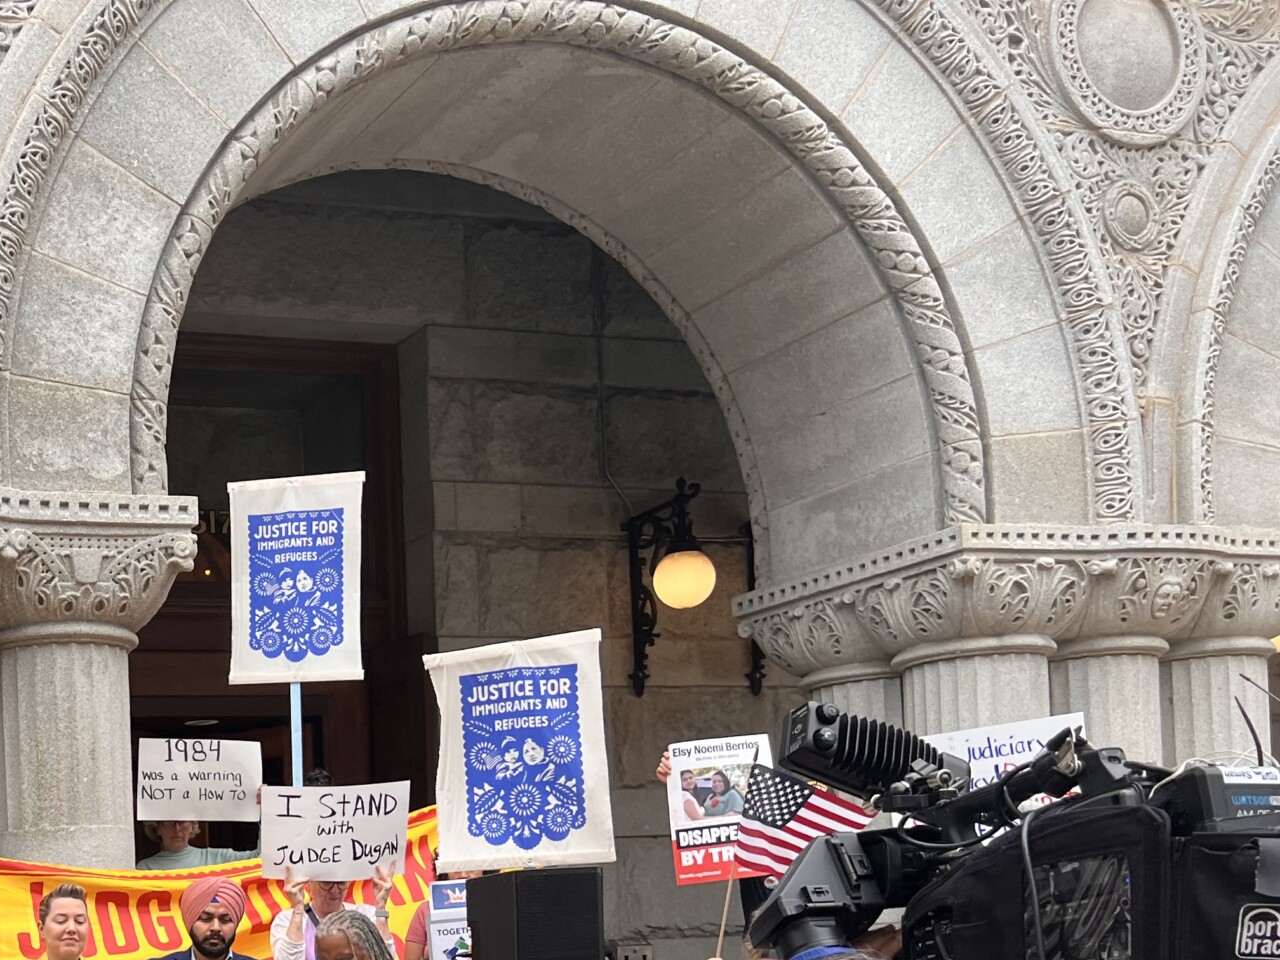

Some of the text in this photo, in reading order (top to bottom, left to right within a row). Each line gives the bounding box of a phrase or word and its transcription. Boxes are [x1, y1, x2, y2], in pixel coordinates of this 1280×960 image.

[254, 519, 338, 539] JUSTICE FOR
[257, 536, 335, 552] IMMIGRANTS AND
[274, 551, 318, 564] REFUGEES
[467, 677, 572, 703] JUSTICE FOR
[471, 697, 568, 717] IMMIGRANTS AND
[494, 715, 549, 732] REFUGEES
[164, 738, 222, 762] 1984
[672, 740, 759, 758] Elsy Noemi Berrios
[141, 770, 242, 787] was a warning
[141, 785, 176, 800] NOT
[182, 790, 190, 800] a
[275, 793, 305, 819] I
[316, 820, 355, 838] with
[678, 824, 738, 848] DISAPPE
[680, 847, 735, 867] BY TR
[437, 926, 472, 937] TOGETH
[1240, 937, 1280, 955] brac
